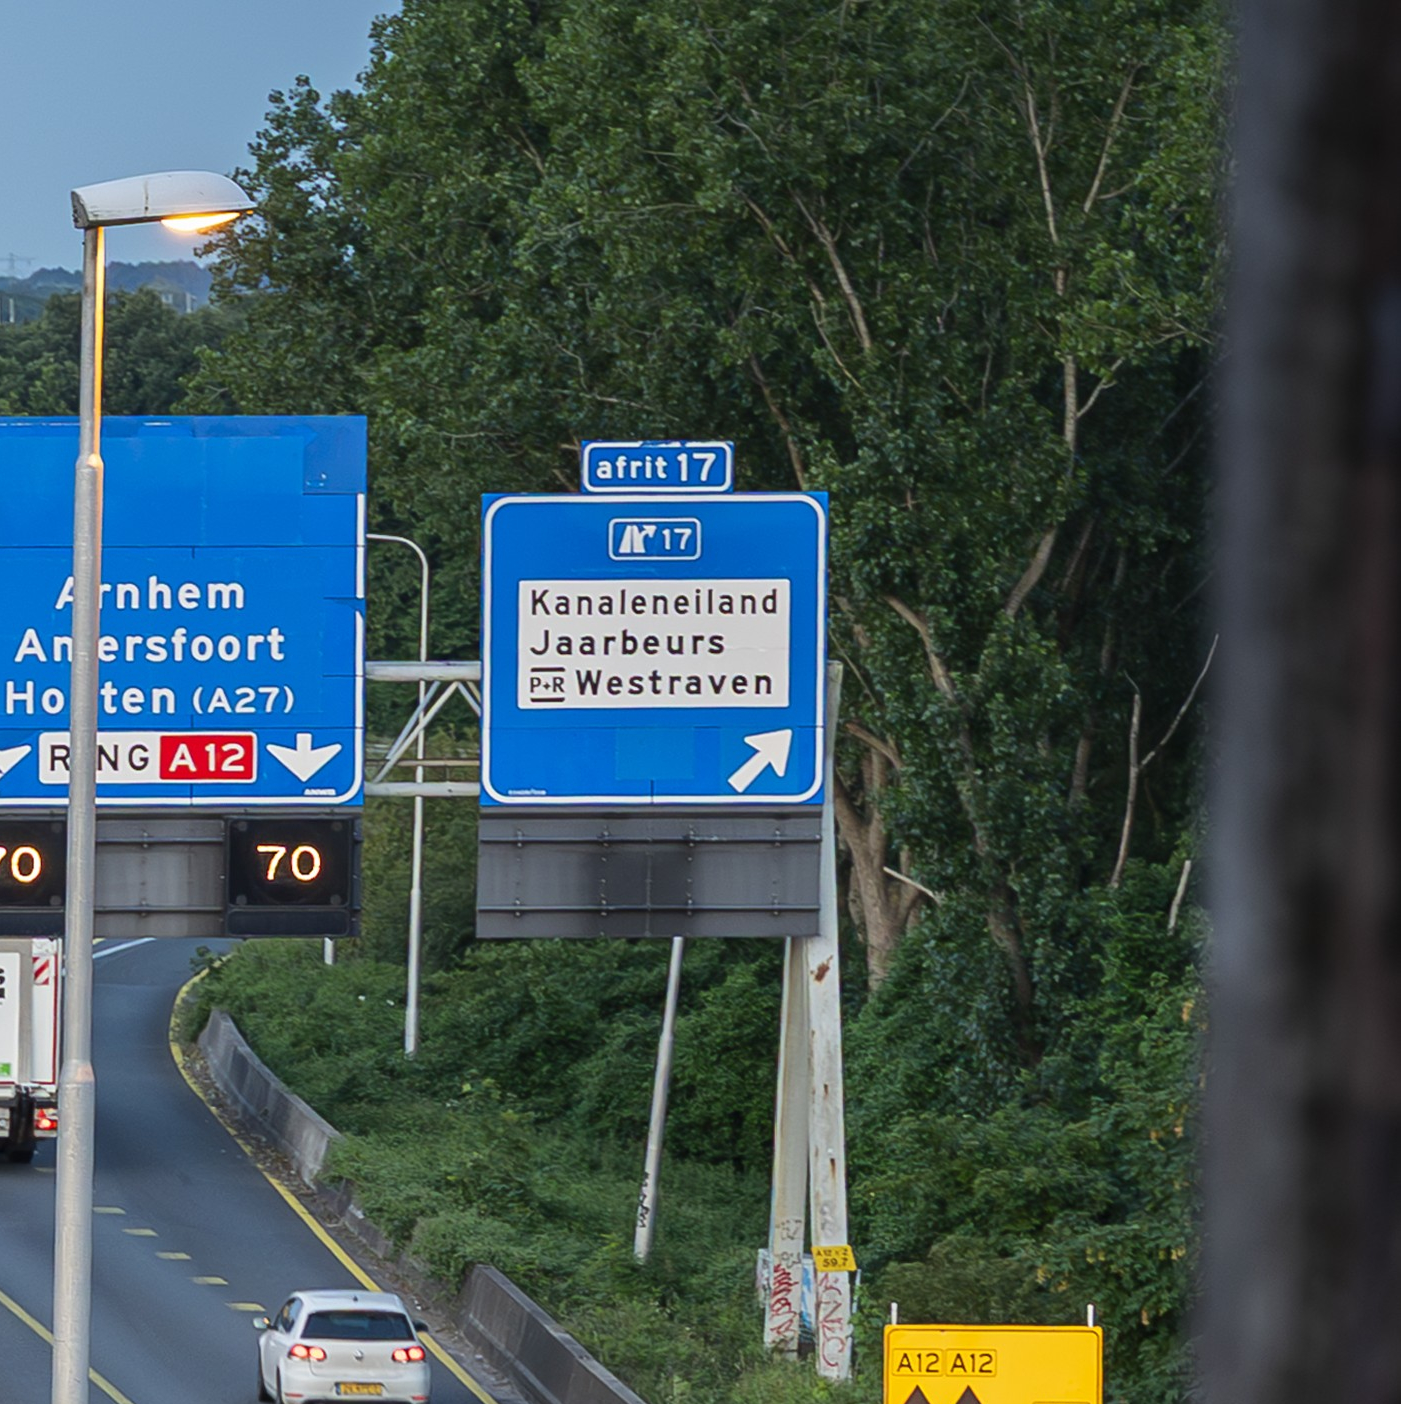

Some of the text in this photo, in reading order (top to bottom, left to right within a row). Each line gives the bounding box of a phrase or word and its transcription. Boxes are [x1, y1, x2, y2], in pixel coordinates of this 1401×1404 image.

[596, 453, 716, 482] afrit 17
[661, 528, 692, 551] 17
[530, 588, 779, 617] Kanaleneiland
[530, 628, 725, 657] Jaarbeurs
[576, 669, 773, 696] Westraven
[5, 680, 294, 715] Hoten (A27)
[49, 742, 246, 774] RNG A12
[257, 844, 322, 882] 70
[896, 1353, 994, 1375] A12 A12
